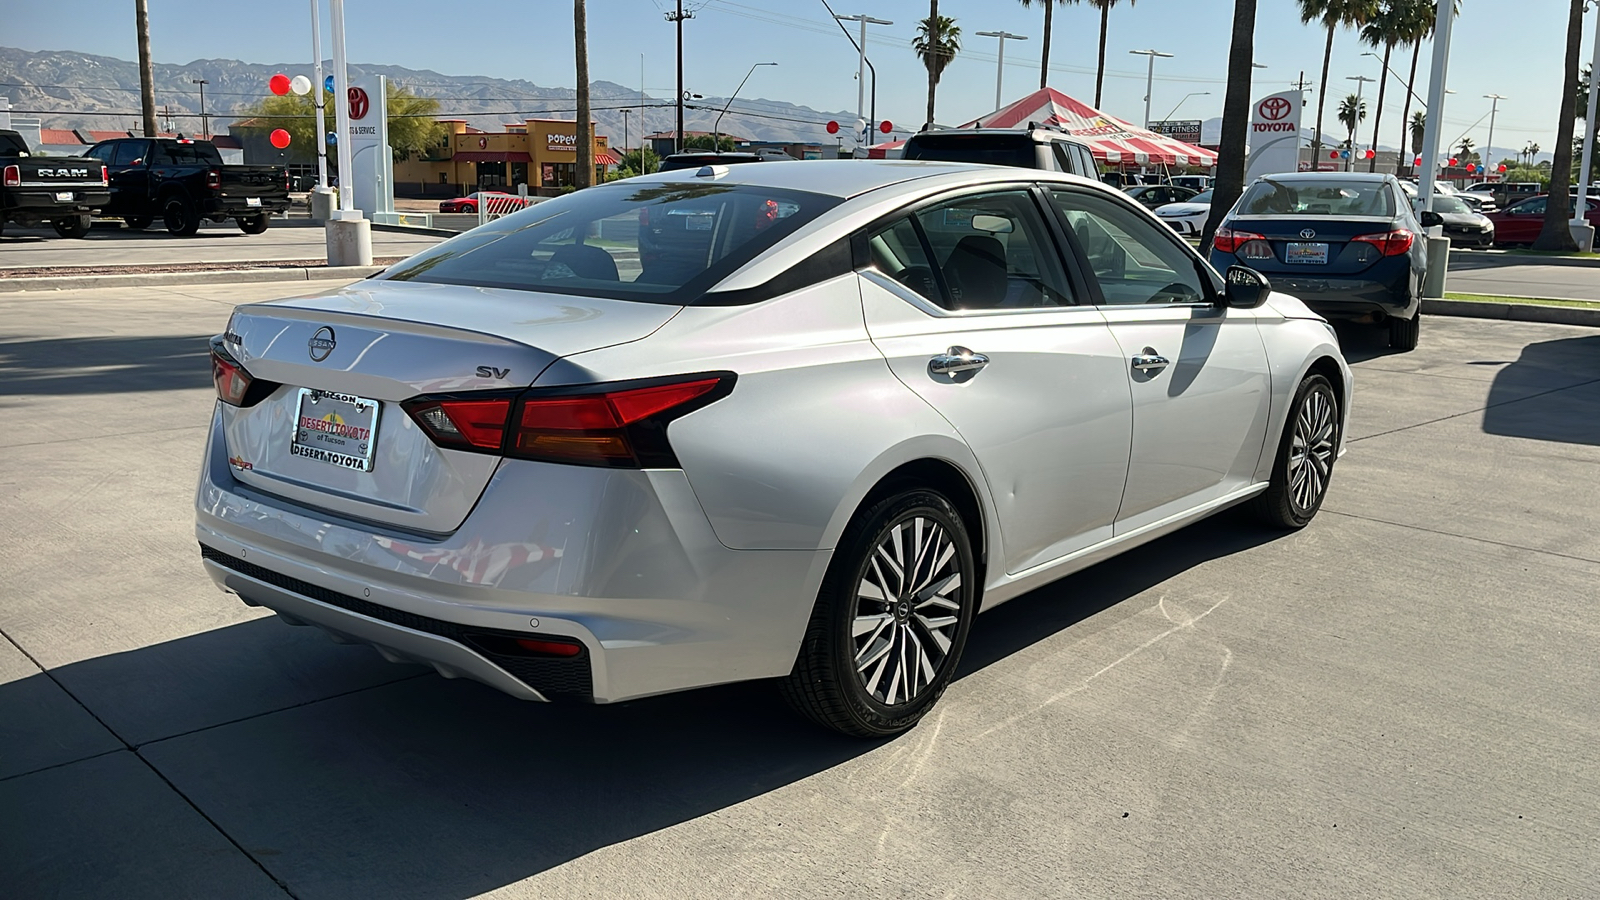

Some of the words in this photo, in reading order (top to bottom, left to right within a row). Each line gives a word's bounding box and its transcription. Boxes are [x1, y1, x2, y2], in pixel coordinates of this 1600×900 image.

[1253, 123, 1295, 132] TOYOTA
[547, 134, 577, 145] POPEY
[38, 169, 88, 177] RAM
[475, 365, 511, 380] SV
[319, 391, 356, 403] TUCSON
[300, 416, 332, 433] DESERT
[335, 423, 371, 441] TOYOTA
[325, 435, 346, 446] Tucson
[294, 446, 325, 461] DESERT
[328, 453, 364, 470] TOYOTA
